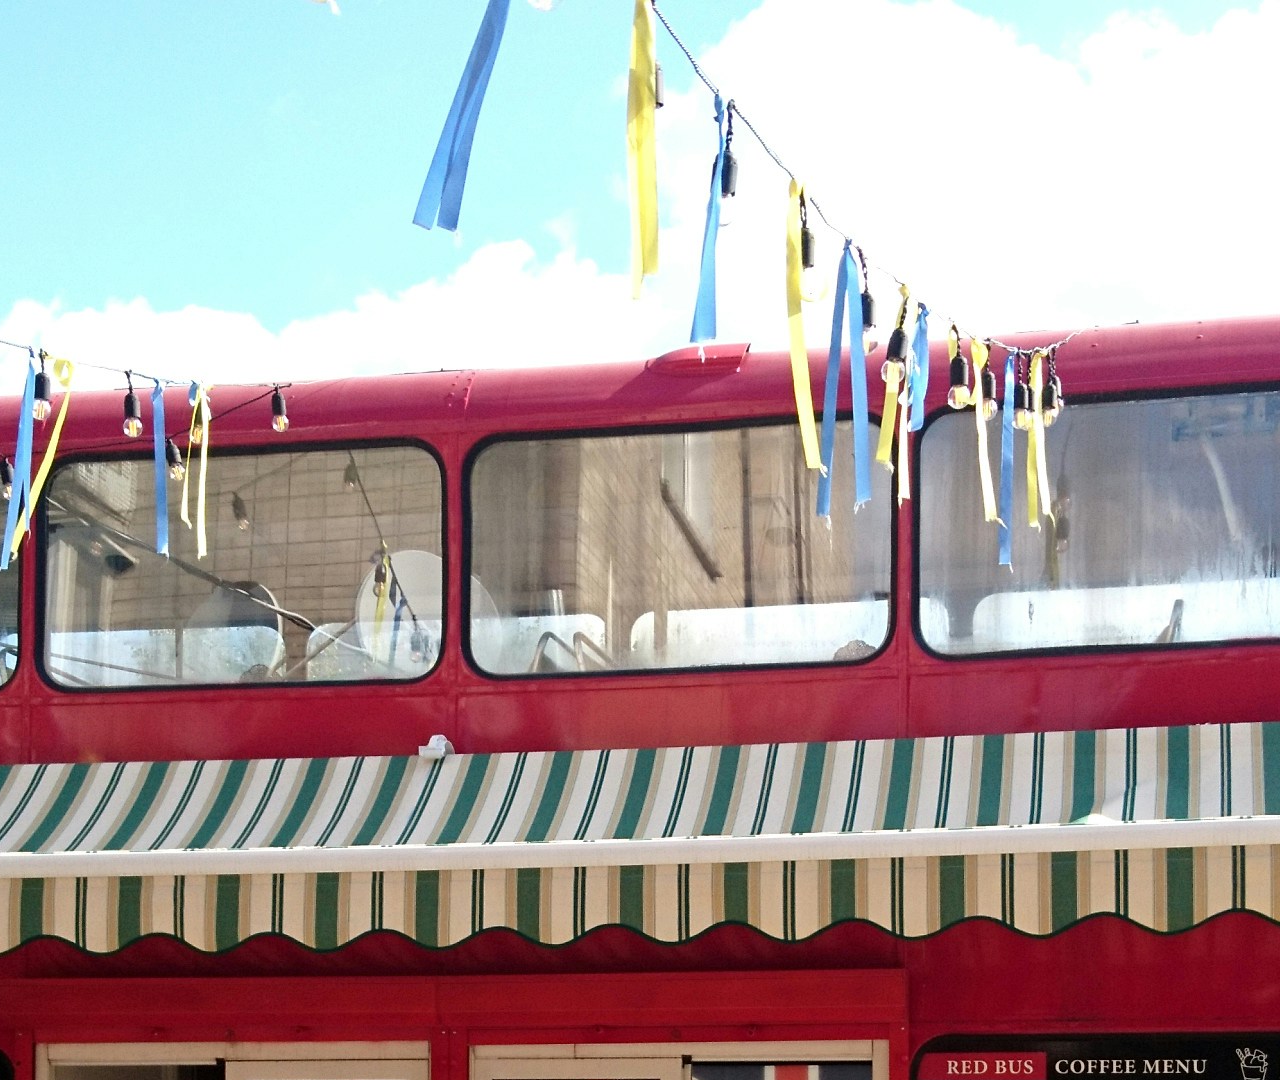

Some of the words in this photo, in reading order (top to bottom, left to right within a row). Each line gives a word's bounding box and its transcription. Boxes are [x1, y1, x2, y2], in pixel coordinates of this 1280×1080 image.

[947, 1060, 987, 1074] RED
[995, 1060, 1033, 1074] BUS
[1055, 1059, 1137, 1074] COFFEE
[1142, 1060, 1208, 1074] MENU
